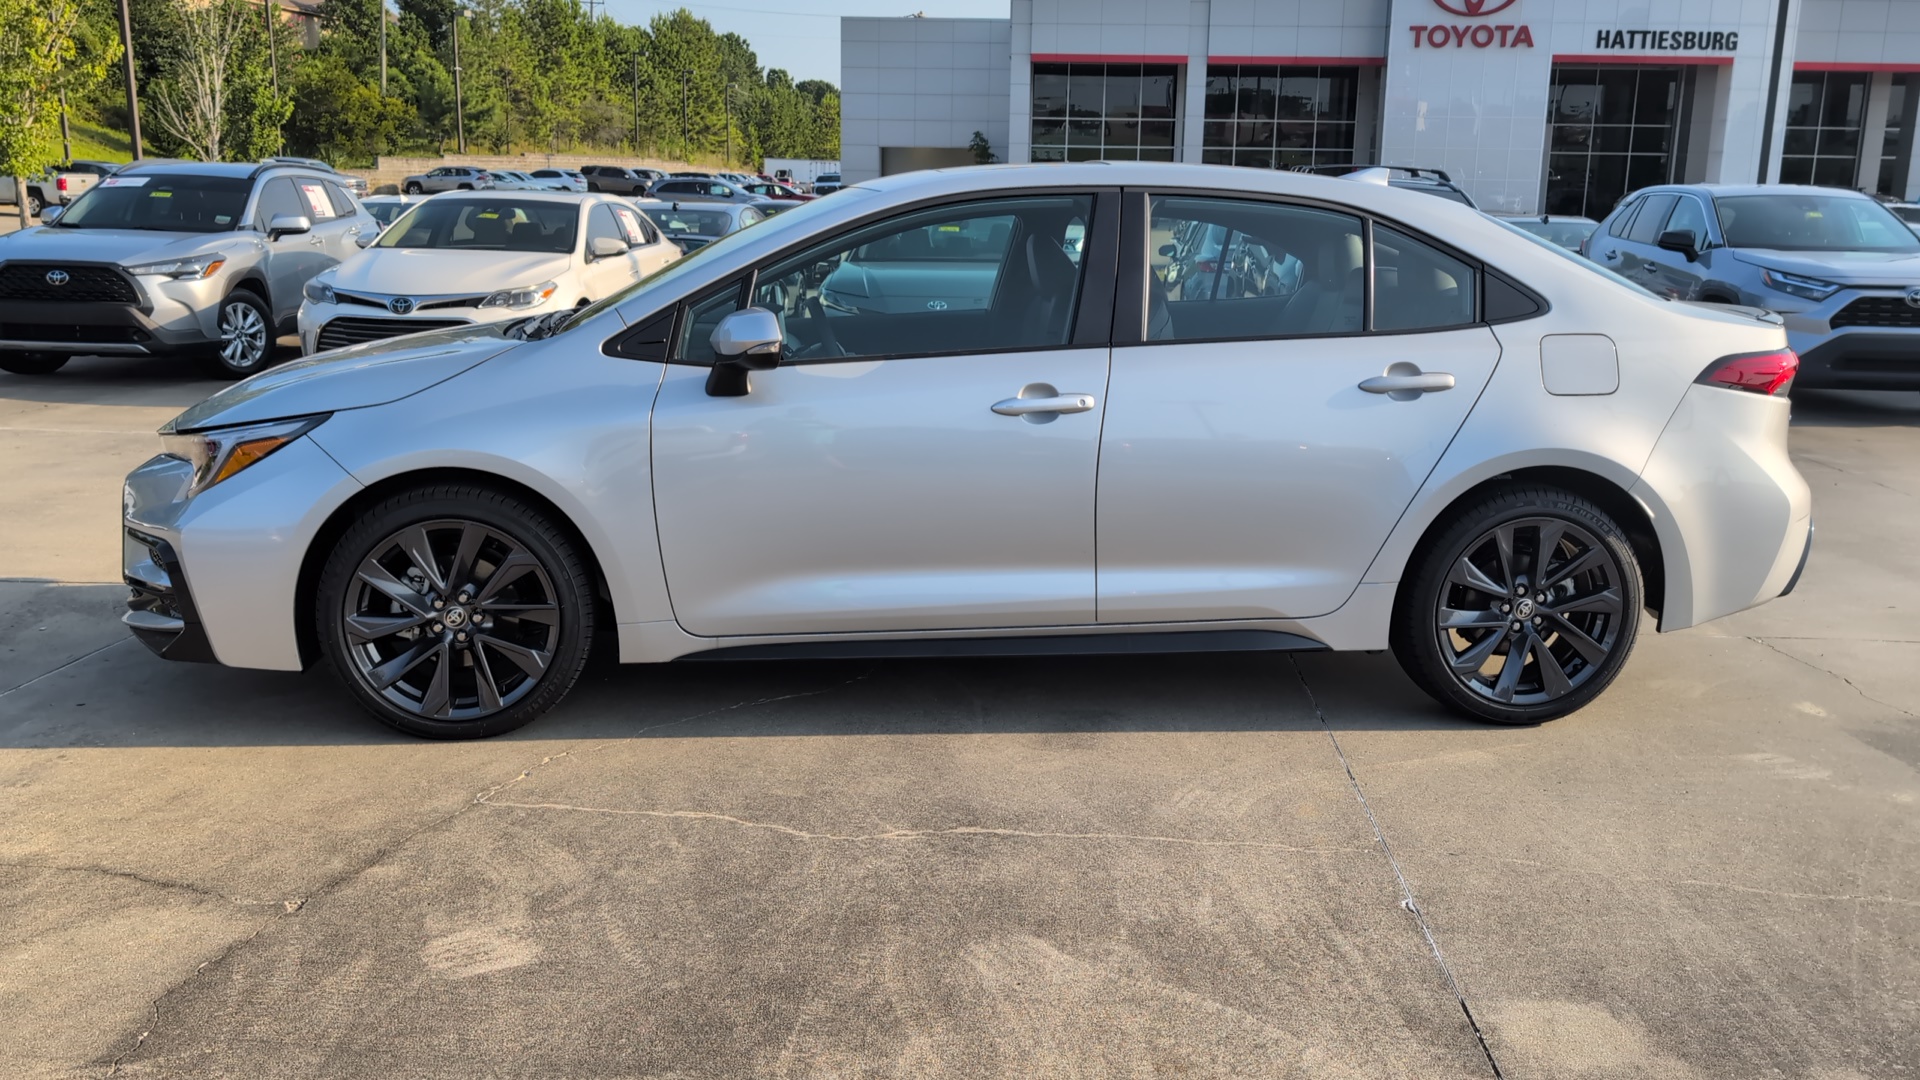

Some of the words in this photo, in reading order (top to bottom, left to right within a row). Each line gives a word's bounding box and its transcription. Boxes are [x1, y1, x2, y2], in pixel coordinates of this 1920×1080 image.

[1409, 24, 1534, 49] TOYOTA
[1596, 29, 1738, 51] HATTIESBURG
[1556, 501, 1611, 534] MICHELIN
